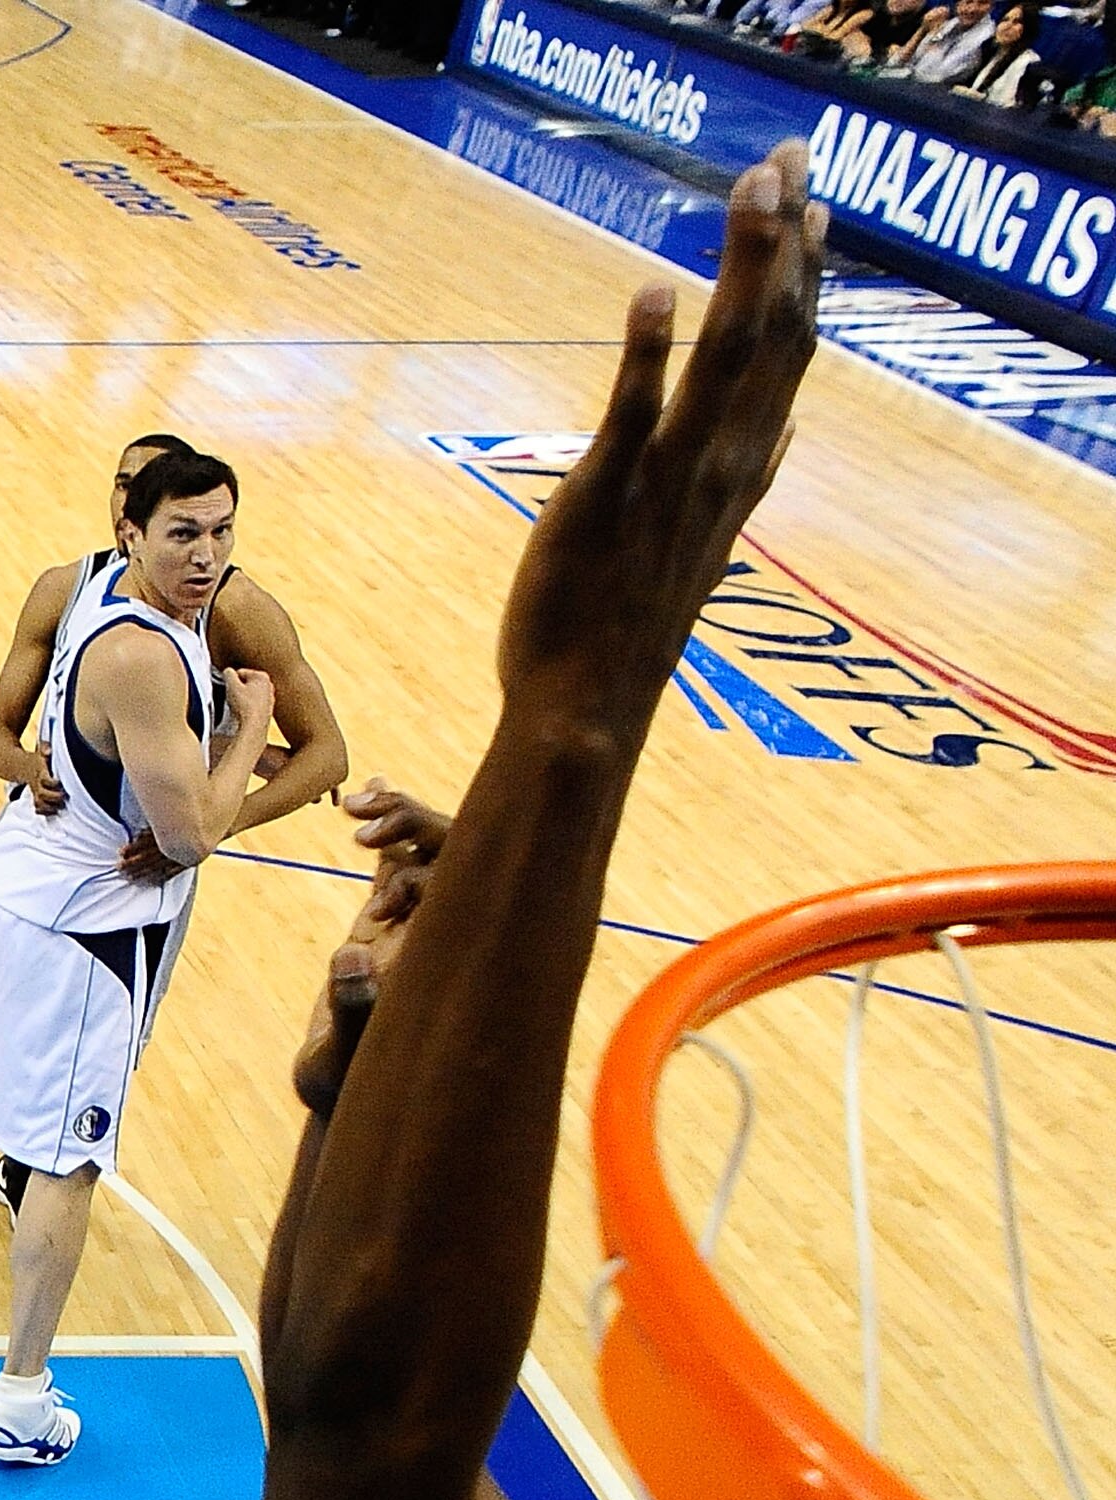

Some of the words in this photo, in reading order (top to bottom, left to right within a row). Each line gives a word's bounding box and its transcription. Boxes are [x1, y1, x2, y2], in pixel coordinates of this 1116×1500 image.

[490, 11, 708, 144] nba.com/tickets
[808, 103, 1040, 272] AMAZING
[1026, 187, 1116, 298] IS
